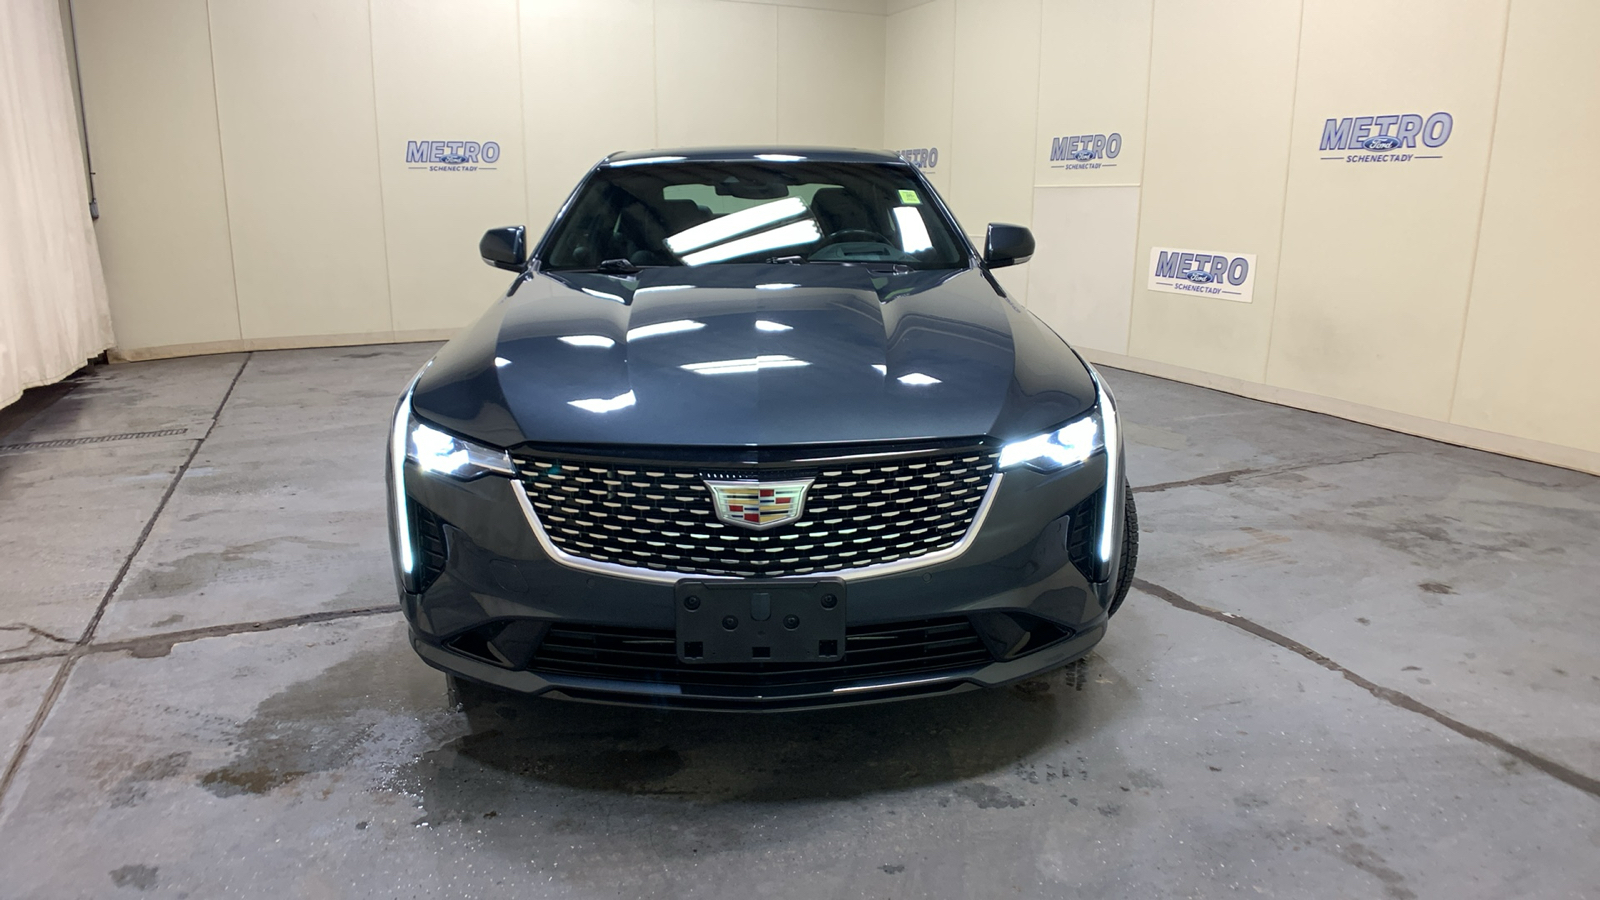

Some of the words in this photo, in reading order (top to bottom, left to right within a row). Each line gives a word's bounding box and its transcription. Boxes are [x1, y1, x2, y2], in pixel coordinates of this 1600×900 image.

[1319, 111, 1453, 151] METRO
[405, 140, 500, 163] METRO
[1050, 132, 1122, 162] METRO
[1367, 138, 1395, 150] Ford
[1065, 162, 1102, 170] SCHENECTADY
[1346, 153, 1414, 163] SCHENECTADY
[1155, 250, 1249, 286] METRO
[1174, 282, 1222, 295] SCHENECTADY
